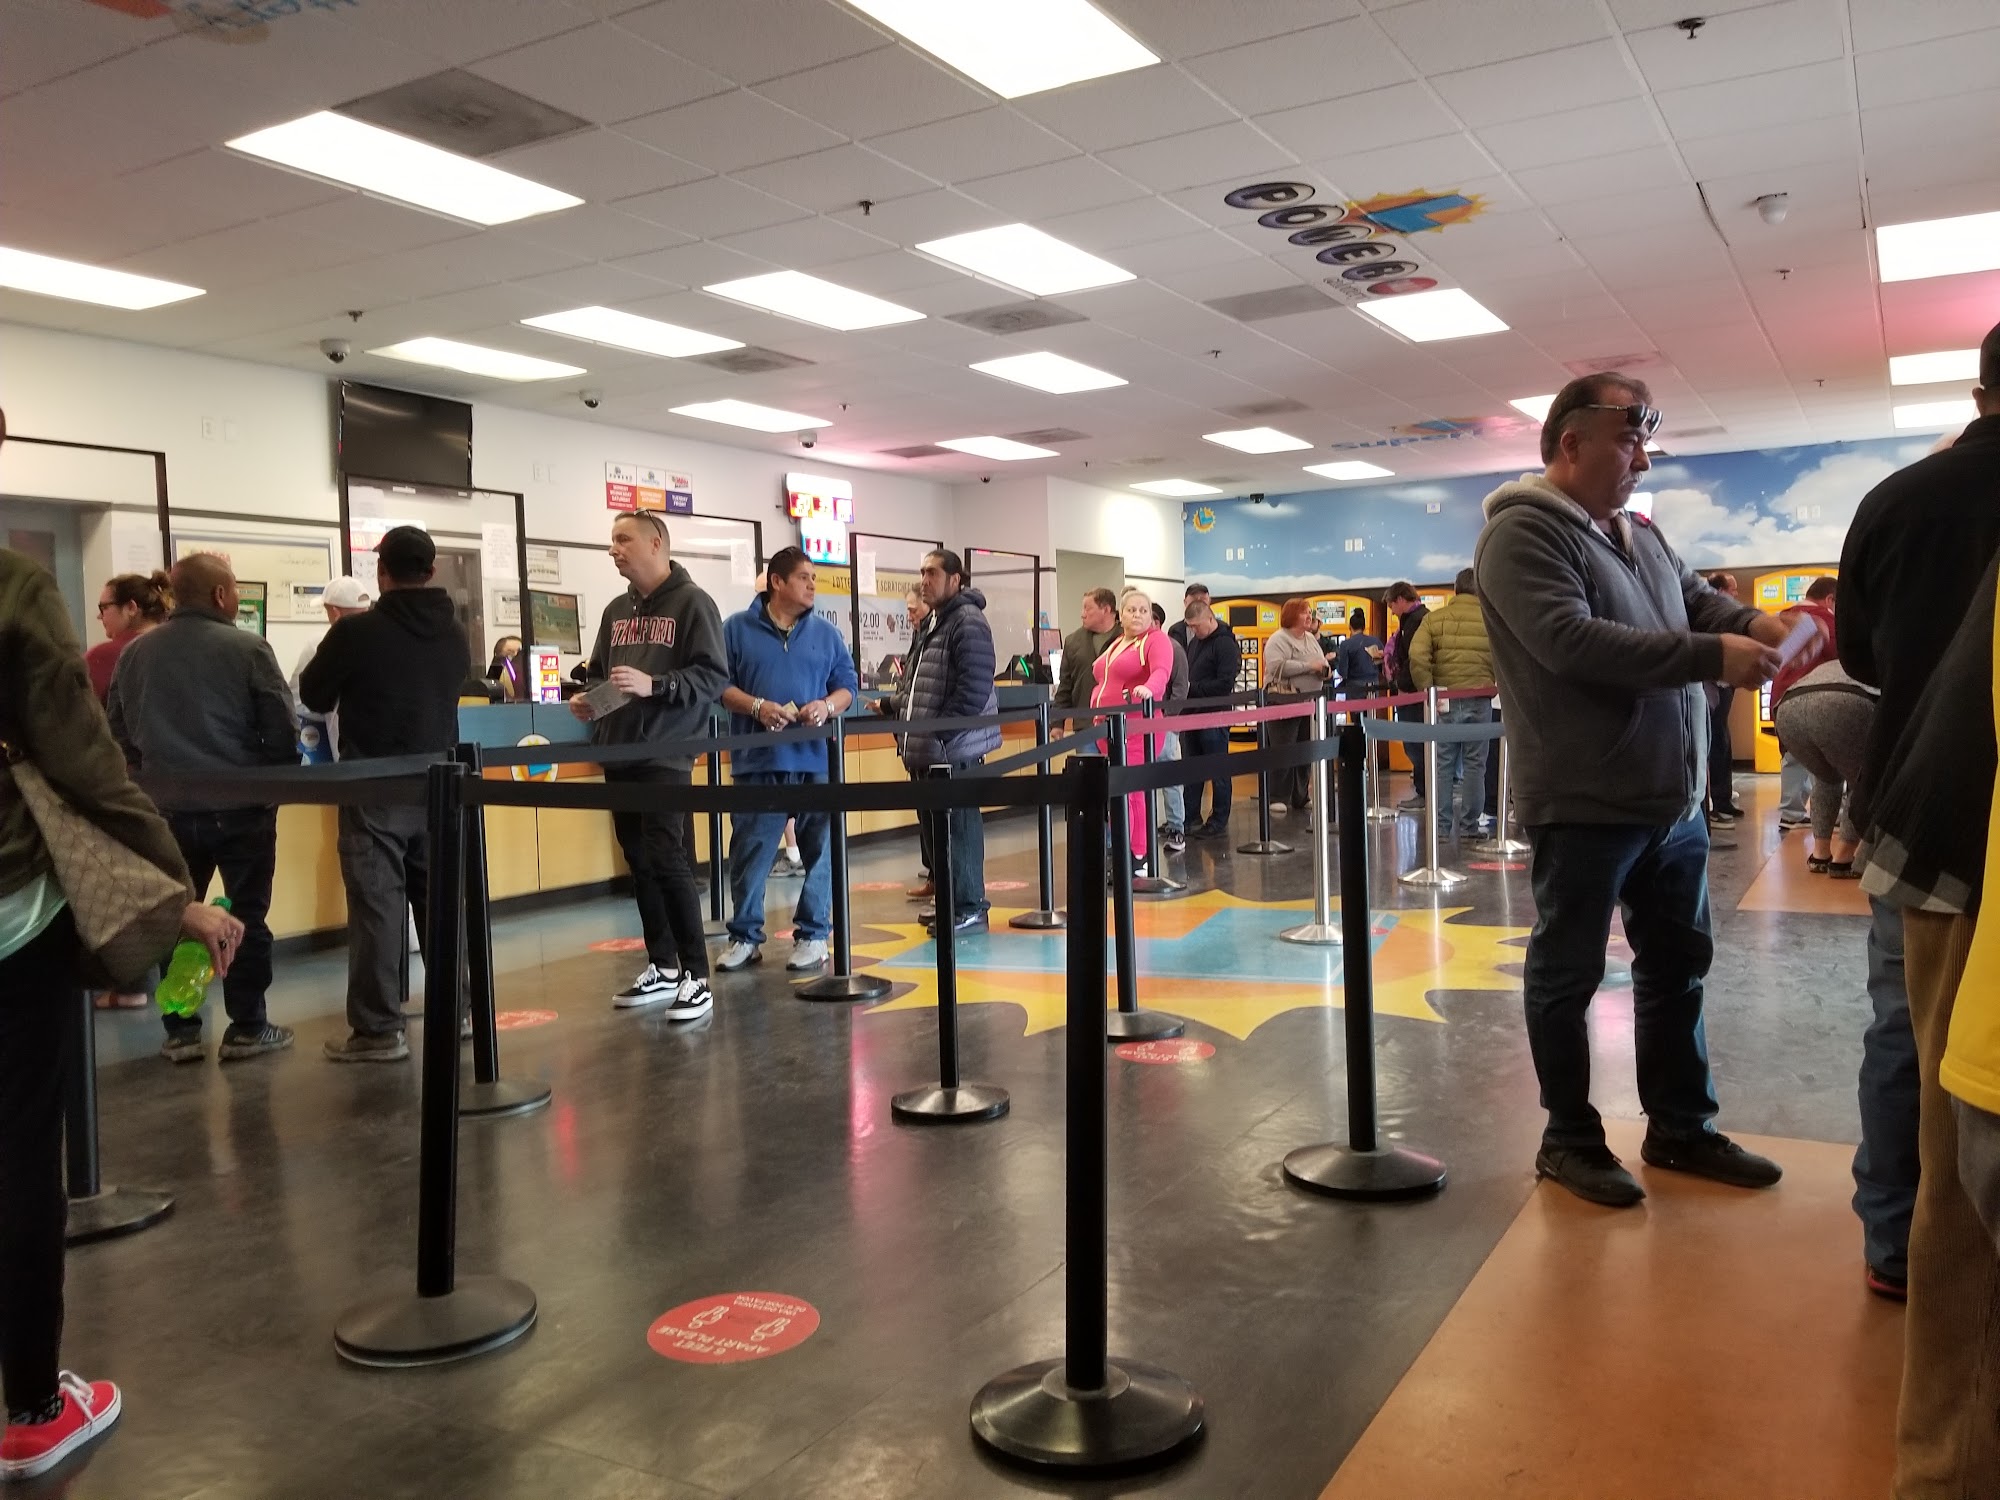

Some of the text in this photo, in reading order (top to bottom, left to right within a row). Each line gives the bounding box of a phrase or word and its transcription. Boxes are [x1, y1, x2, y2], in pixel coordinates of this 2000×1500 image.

[832, 575, 851, 589] LOTTE
[895, 613, 911, 631] $3.0
[611, 616, 677, 649] TANFORD
[656, 1325, 770, 1354] APART PLEASE
[673, 1339, 714, 1354] FEET
